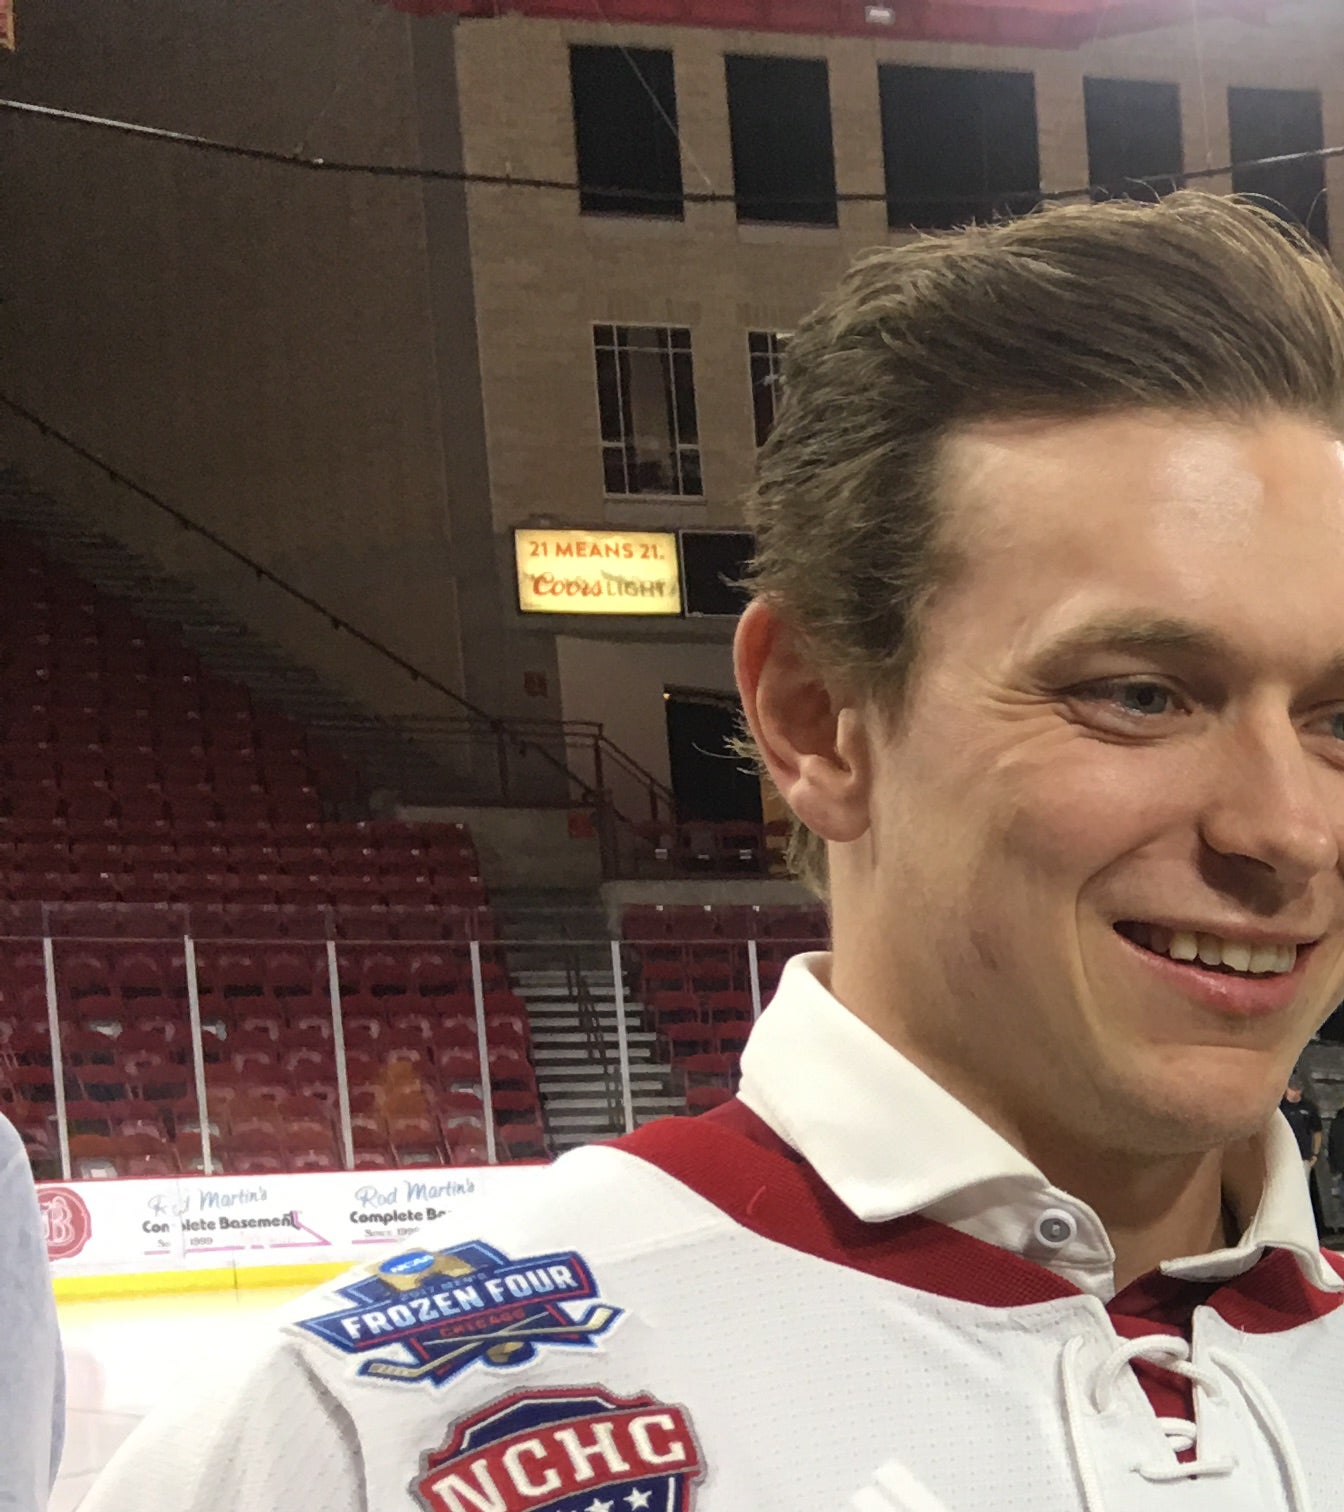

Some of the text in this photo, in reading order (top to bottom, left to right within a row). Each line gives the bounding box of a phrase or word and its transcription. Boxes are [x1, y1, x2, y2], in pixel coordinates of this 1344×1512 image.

[529, 541, 548, 557] 21
[555, 541, 633, 558] MEANS
[533, 572, 666, 597] Coors LIGHT
[349, 1208, 424, 1226] Complete
[340, 1264, 579, 1339] FROZEN FOUR
